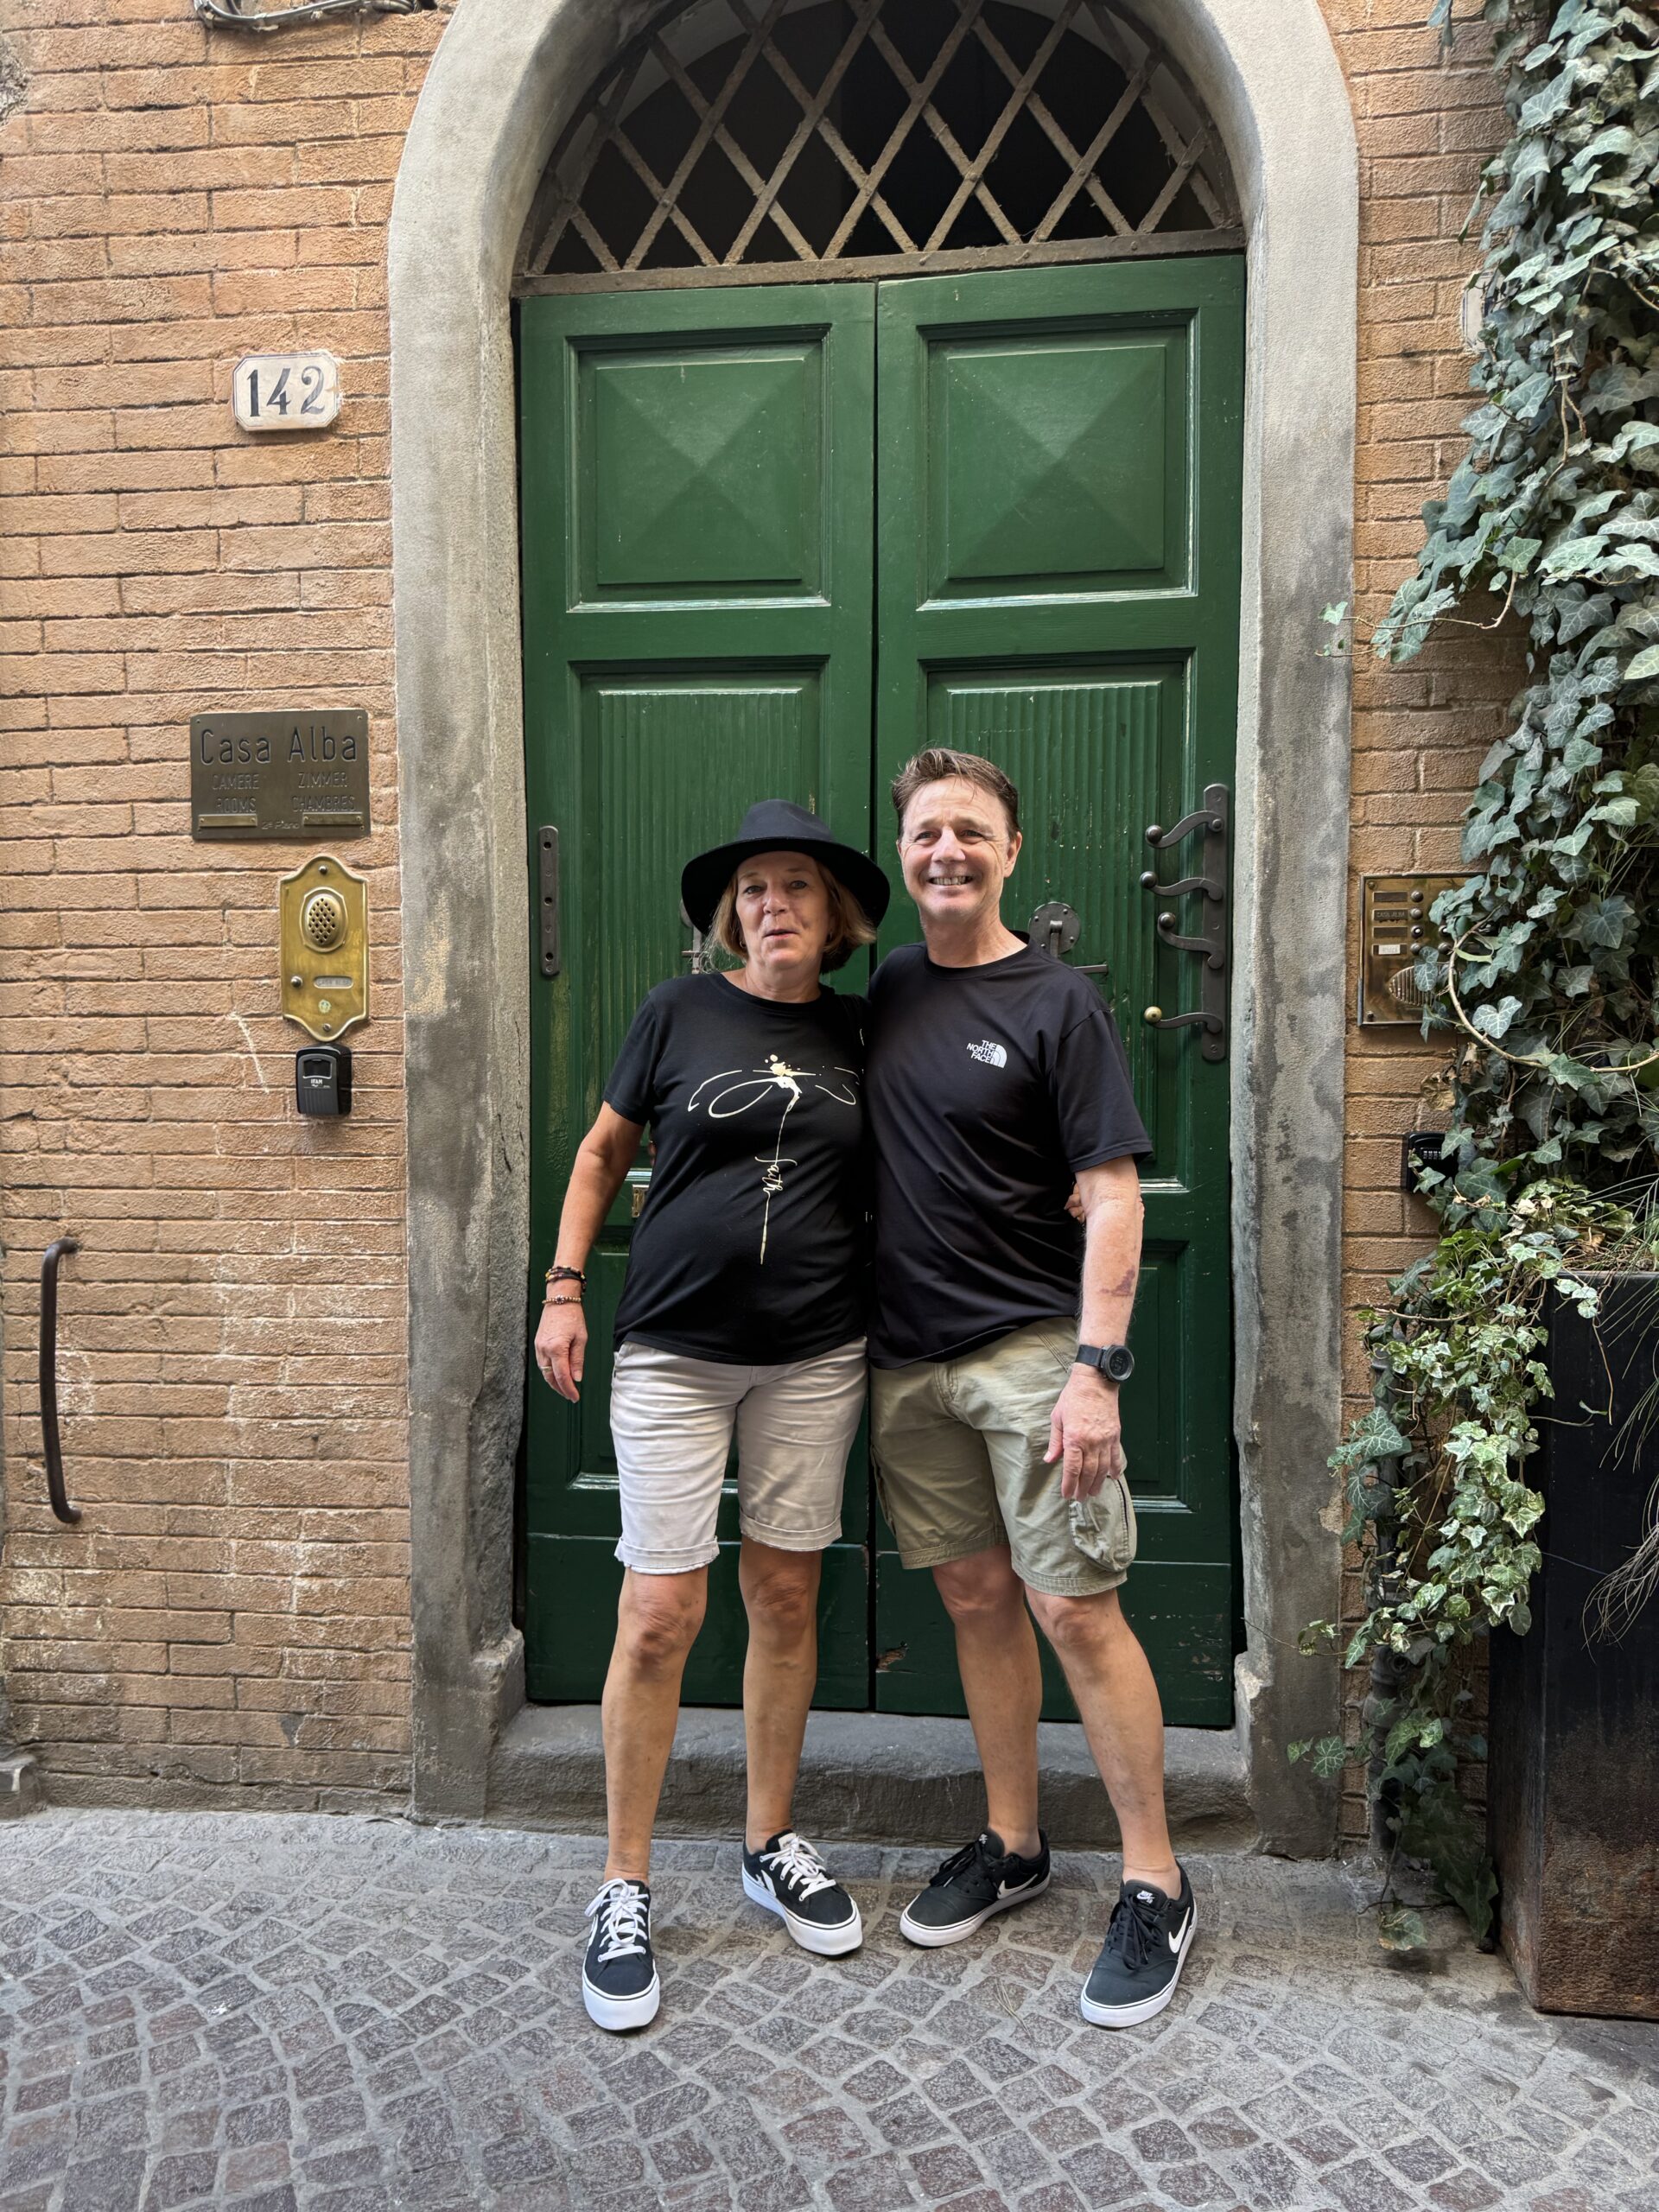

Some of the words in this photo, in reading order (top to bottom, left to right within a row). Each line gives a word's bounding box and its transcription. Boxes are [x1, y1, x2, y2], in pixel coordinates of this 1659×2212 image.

[246, 365, 326, 417] 142
[200, 728, 271, 766] Casa
[287, 726, 358, 763] Alba
[212, 773, 259, 791] CAMERE
[298, 772, 348, 789] ZIMMER
[216, 797, 257, 813] ROOMS
[291, 795, 355, 812] CHAMBRES
[966, 1043, 994, 1057] NORTH
[982, 1039, 997, 1051] THE
[970, 1052, 992, 1064] FACE
